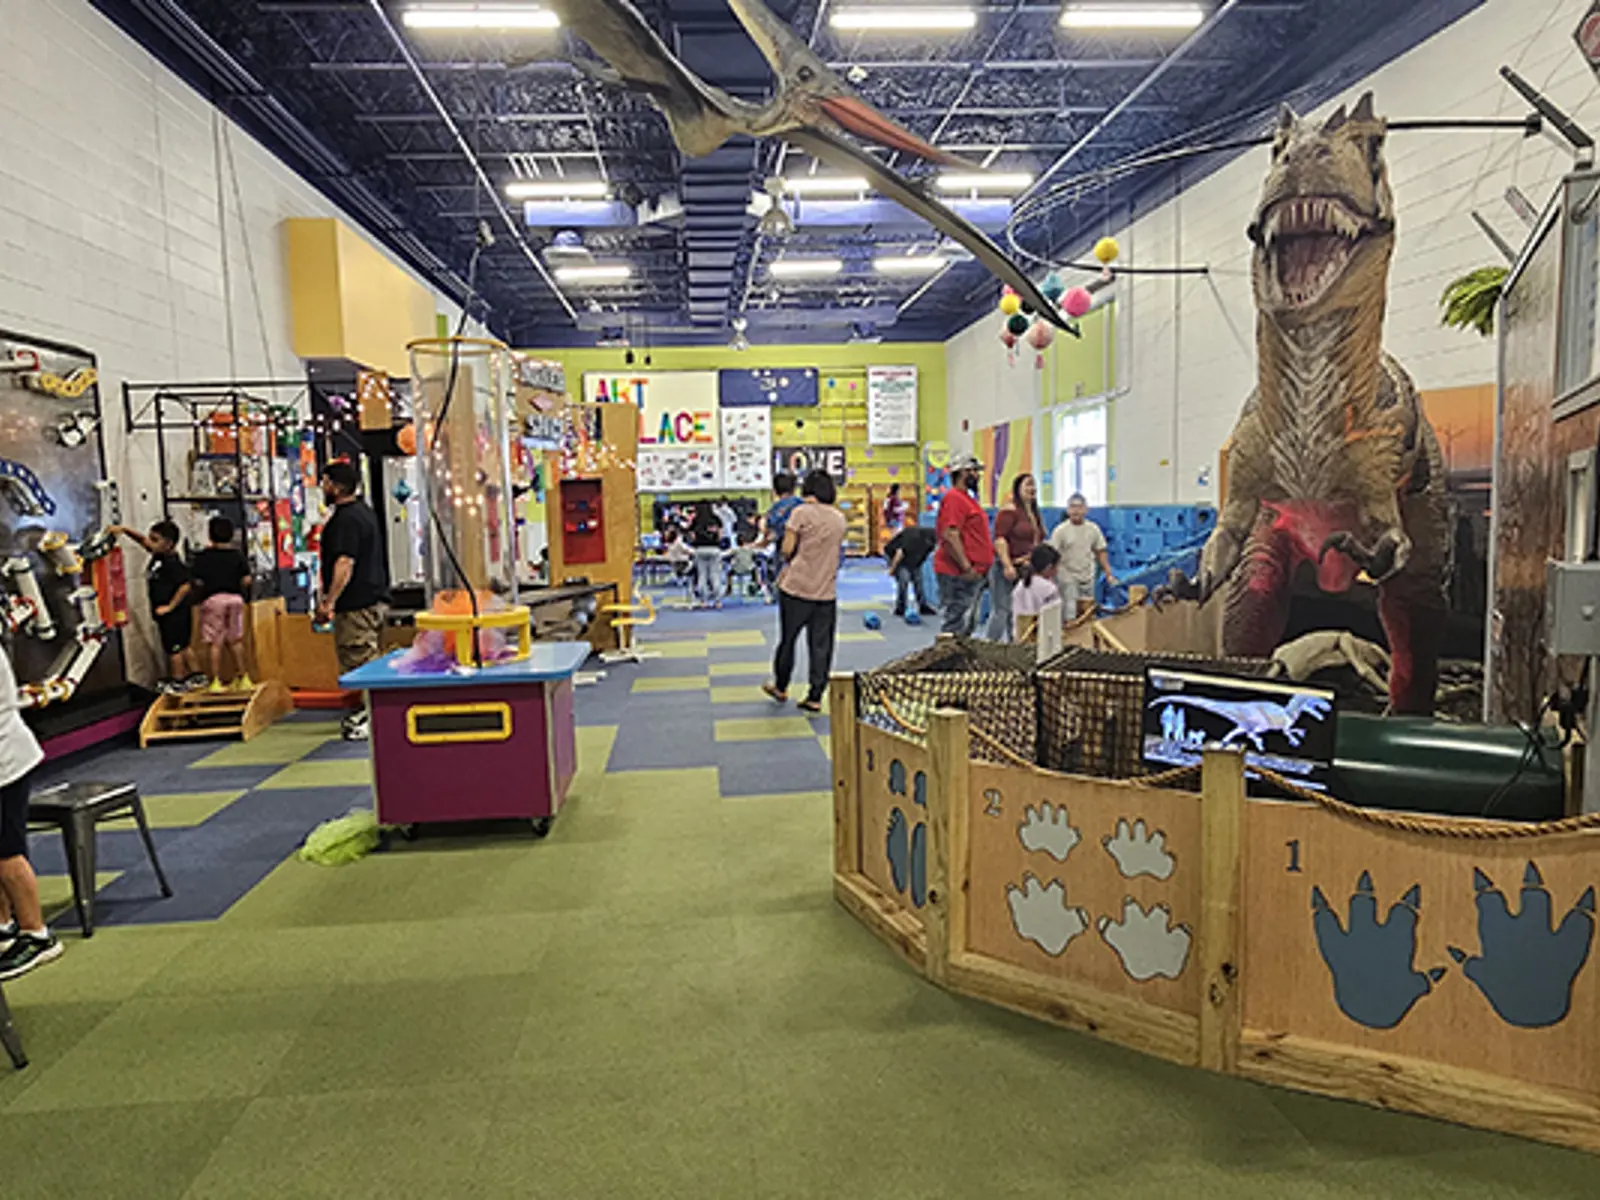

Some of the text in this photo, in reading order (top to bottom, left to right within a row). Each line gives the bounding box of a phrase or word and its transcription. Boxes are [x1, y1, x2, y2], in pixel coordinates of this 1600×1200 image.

[595, 378, 648, 409] ART
[638, 411, 712, 443] LACE
[775, 450, 843, 476] LOVE
[983, 788, 1003, 818] 2
[1285, 839, 1302, 873] 1
